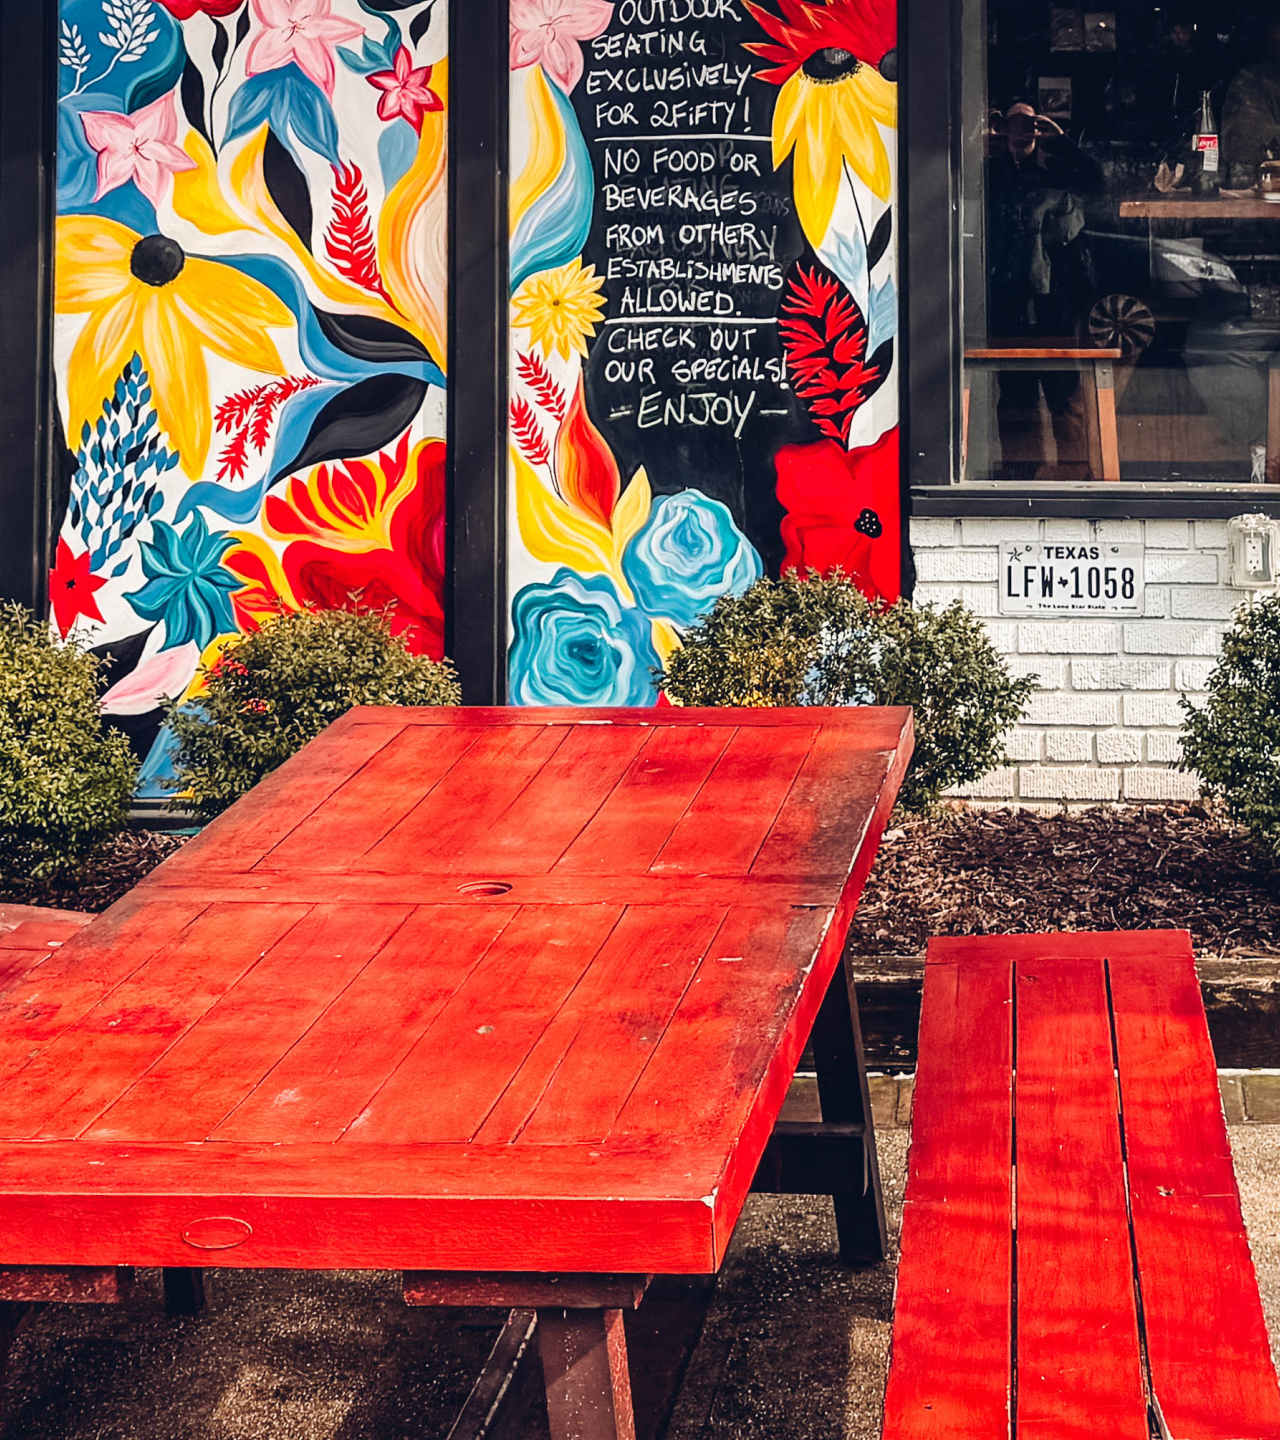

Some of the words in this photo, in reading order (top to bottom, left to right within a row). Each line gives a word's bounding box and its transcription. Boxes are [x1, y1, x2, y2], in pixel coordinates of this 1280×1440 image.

[596, 101, 639, 128] FOR
[604, 148, 641, 179] NO
[653, 147, 715, 173] FOOD
[730, 153, 761, 177] OR
[602, 183, 757, 216] BEVERAGES
[606, 224, 665, 249] FROM
[679, 222, 762, 250] OTHER
[621, 286, 742, 316] ALLOWED.
[608, 327, 696, 353] CHECK
[710, 328, 758, 351] OUT
[604, 358, 656, 385] OUR
[1043, 546, 1100, 560] TEXAS
